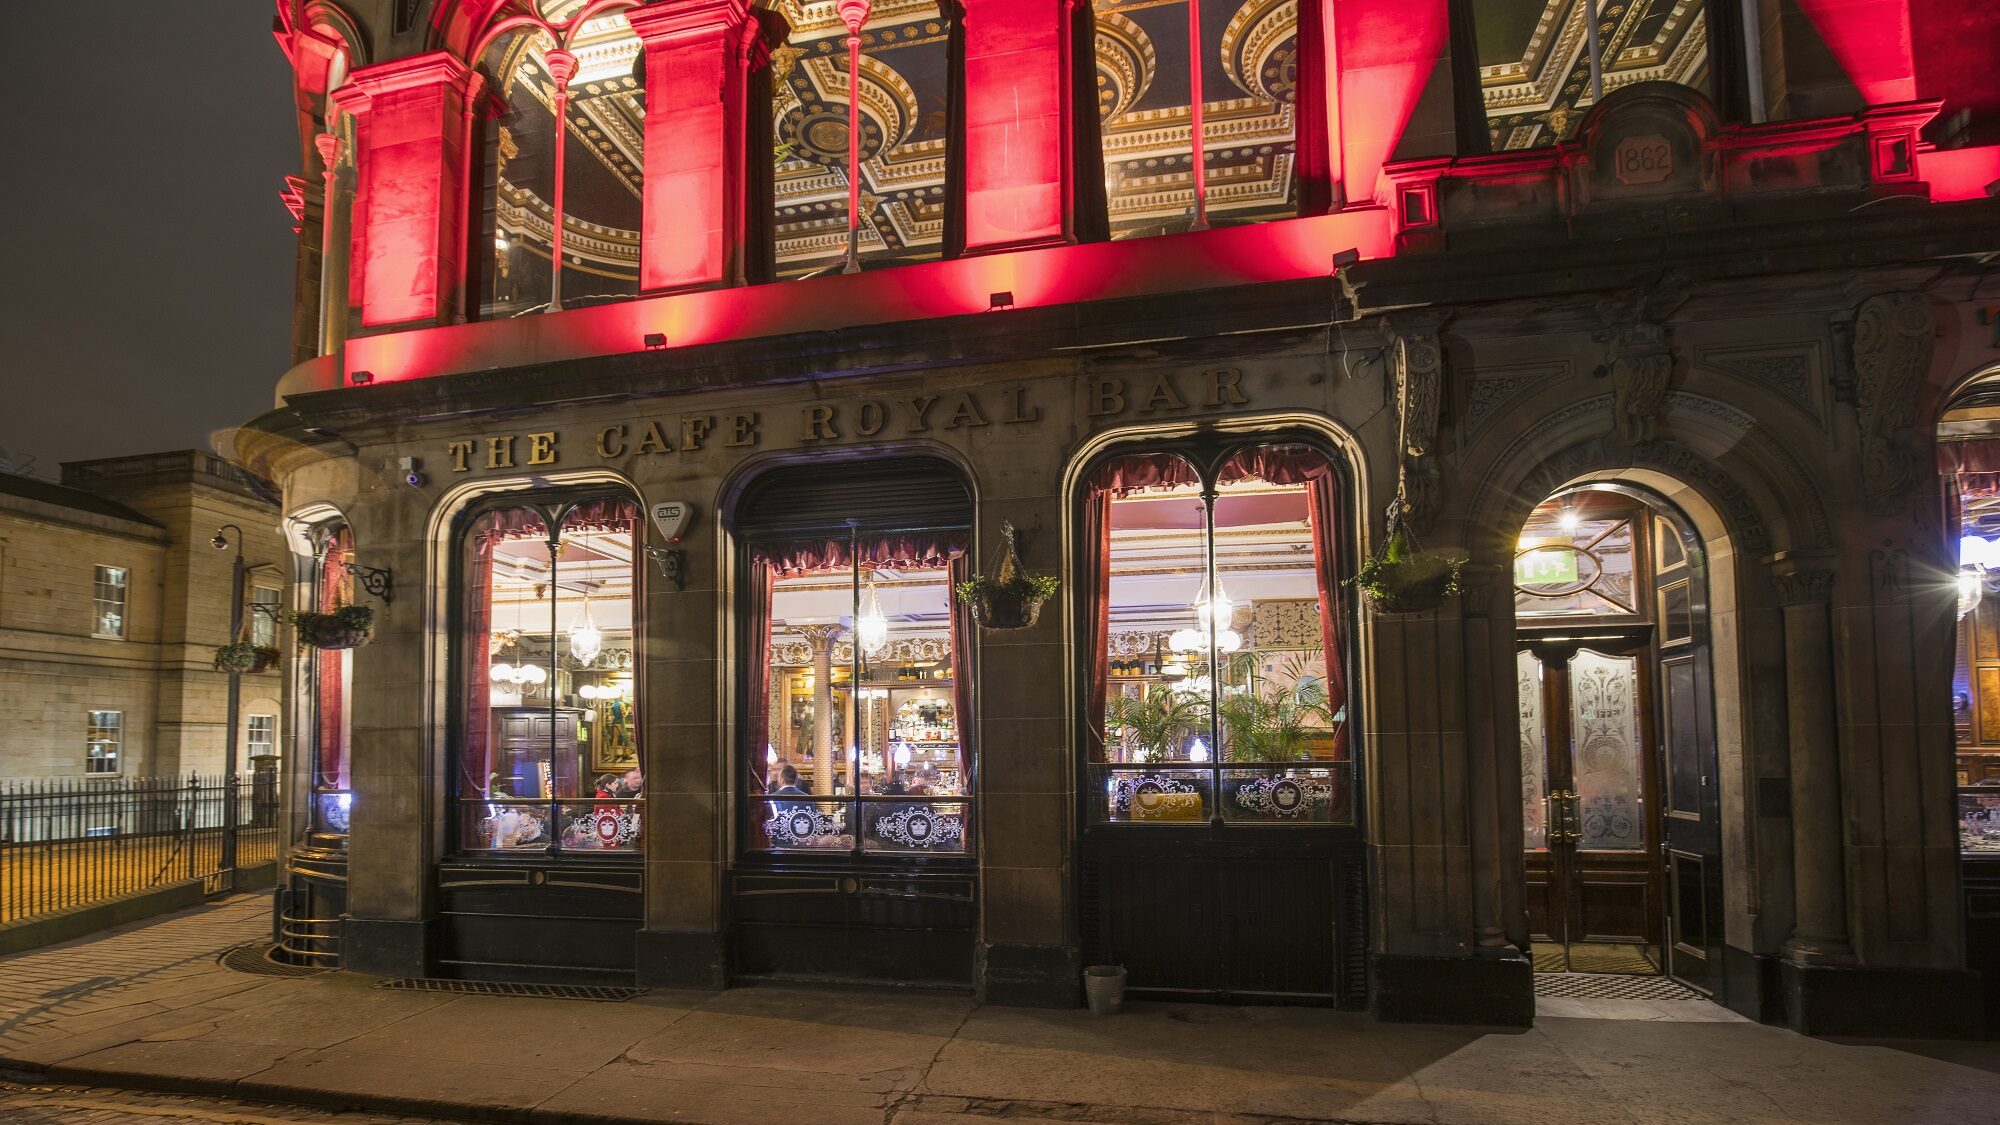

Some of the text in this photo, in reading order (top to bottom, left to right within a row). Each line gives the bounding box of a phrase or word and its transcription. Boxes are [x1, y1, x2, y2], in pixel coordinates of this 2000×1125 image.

[1618, 145, 1669, 173] 1862
[448, 368, 1249, 472] THE CAFE ROYAL BAR
[1707, 471, 1770, 553] BUFFET
